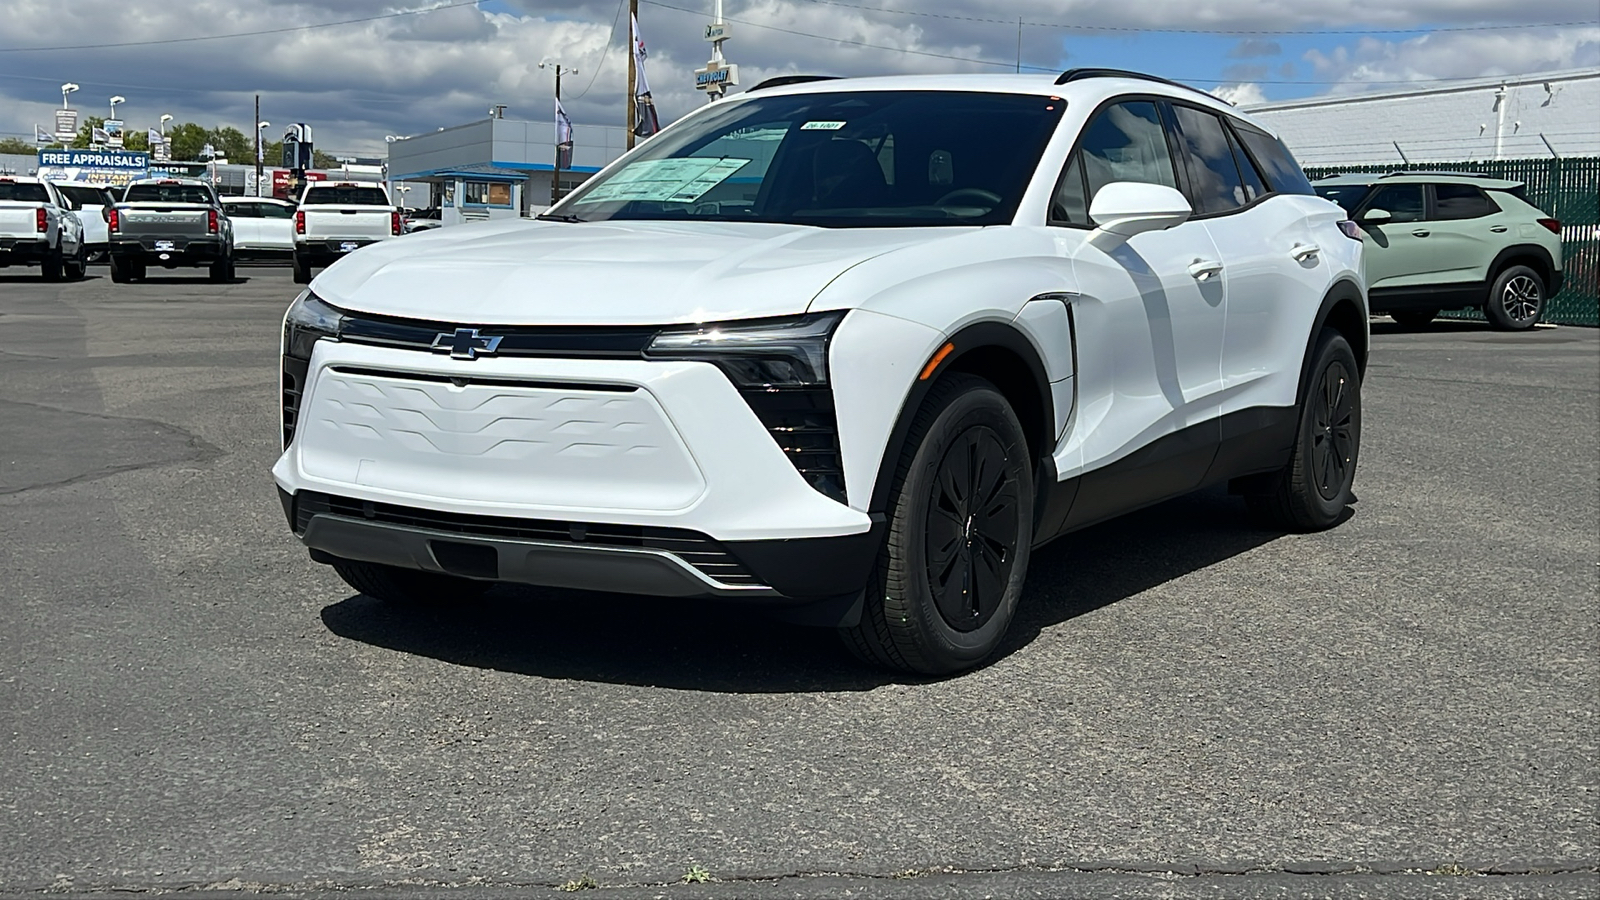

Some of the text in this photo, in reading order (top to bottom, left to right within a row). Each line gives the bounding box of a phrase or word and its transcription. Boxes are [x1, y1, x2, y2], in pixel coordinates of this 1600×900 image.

[42, 153, 146, 167] FREE APPRAISALS!
[87, 173, 134, 181] INSTANT
